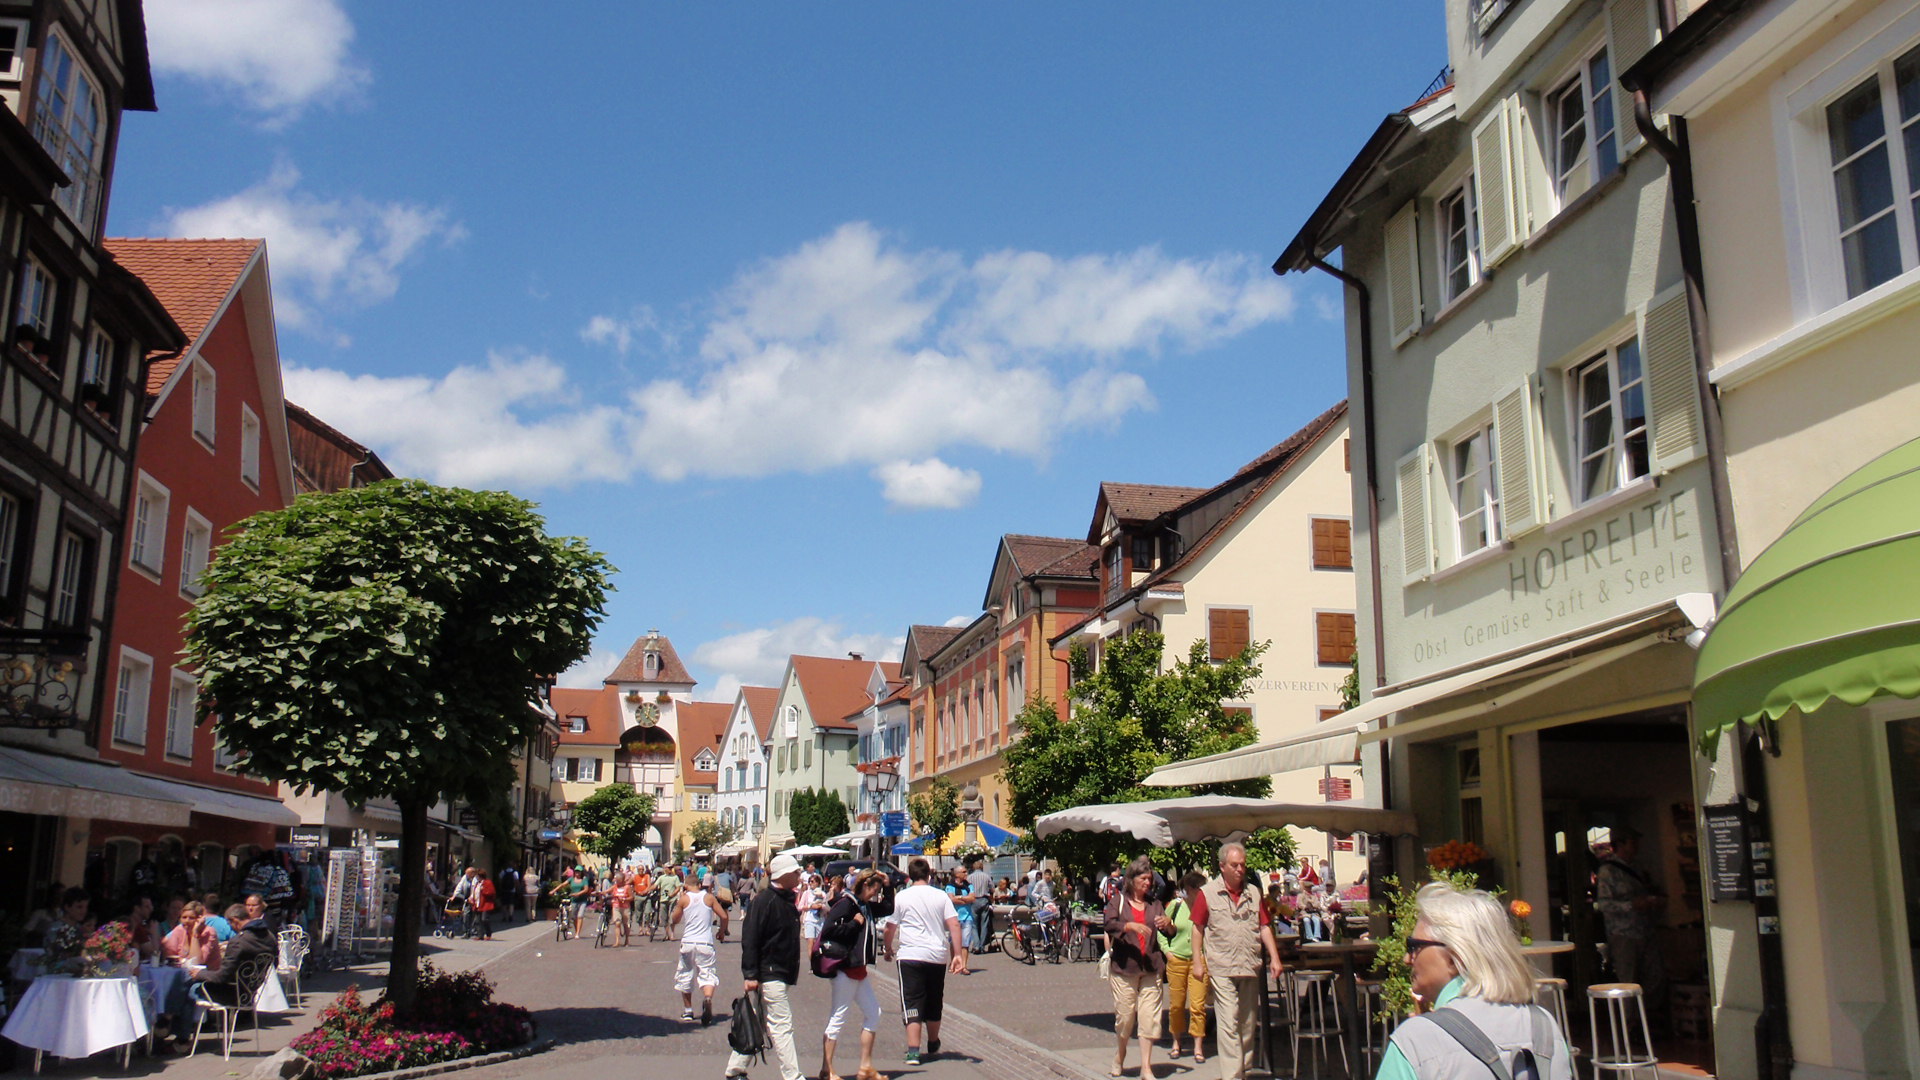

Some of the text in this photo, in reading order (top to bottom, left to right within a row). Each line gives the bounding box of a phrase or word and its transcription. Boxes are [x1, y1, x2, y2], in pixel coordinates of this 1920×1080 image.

[1414, 551, 1692, 663] Obst Gemüse Saft & Seele
